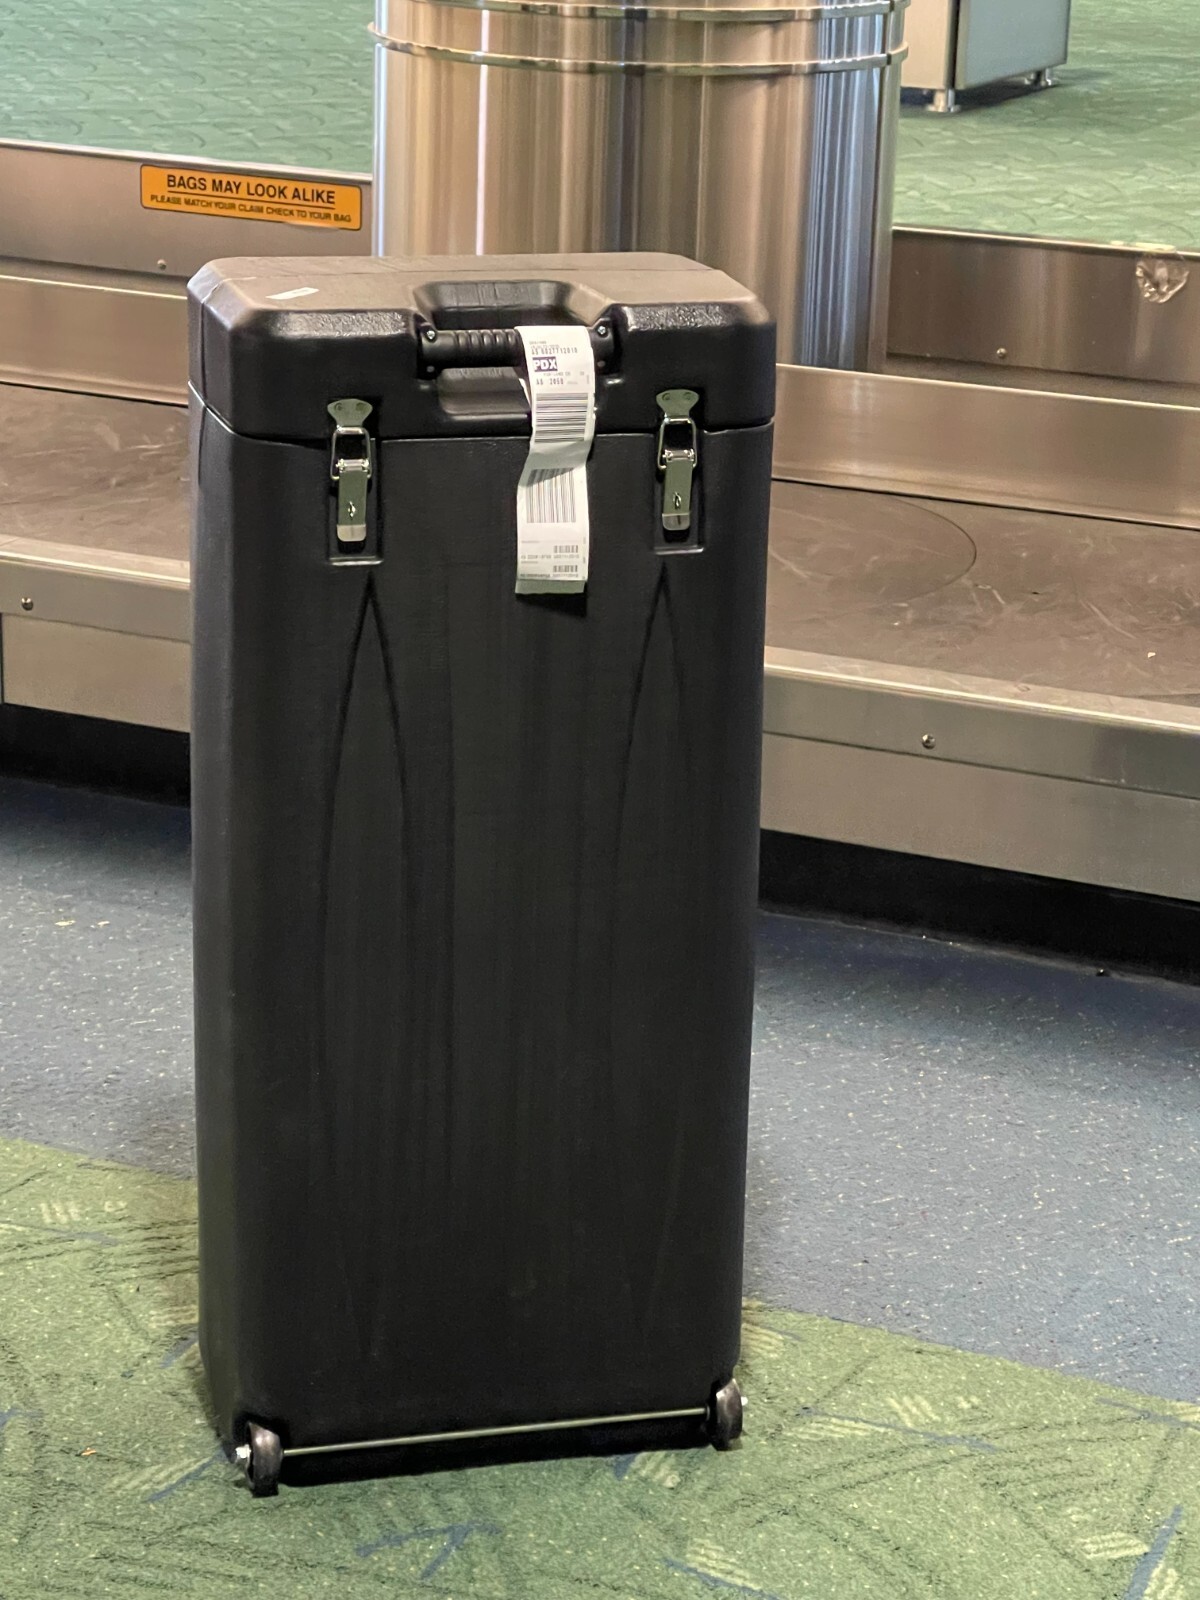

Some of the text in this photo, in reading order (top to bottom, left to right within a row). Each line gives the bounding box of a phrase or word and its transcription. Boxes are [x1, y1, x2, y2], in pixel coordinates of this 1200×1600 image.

[167, 174, 336, 205] BAGS MAY LOOK ALIKE
[150, 194, 352, 223] PLEASE MATCH YOUR CLAIM CHECK TO YOUR BAG
[533, 358, 557, 371] PDX
